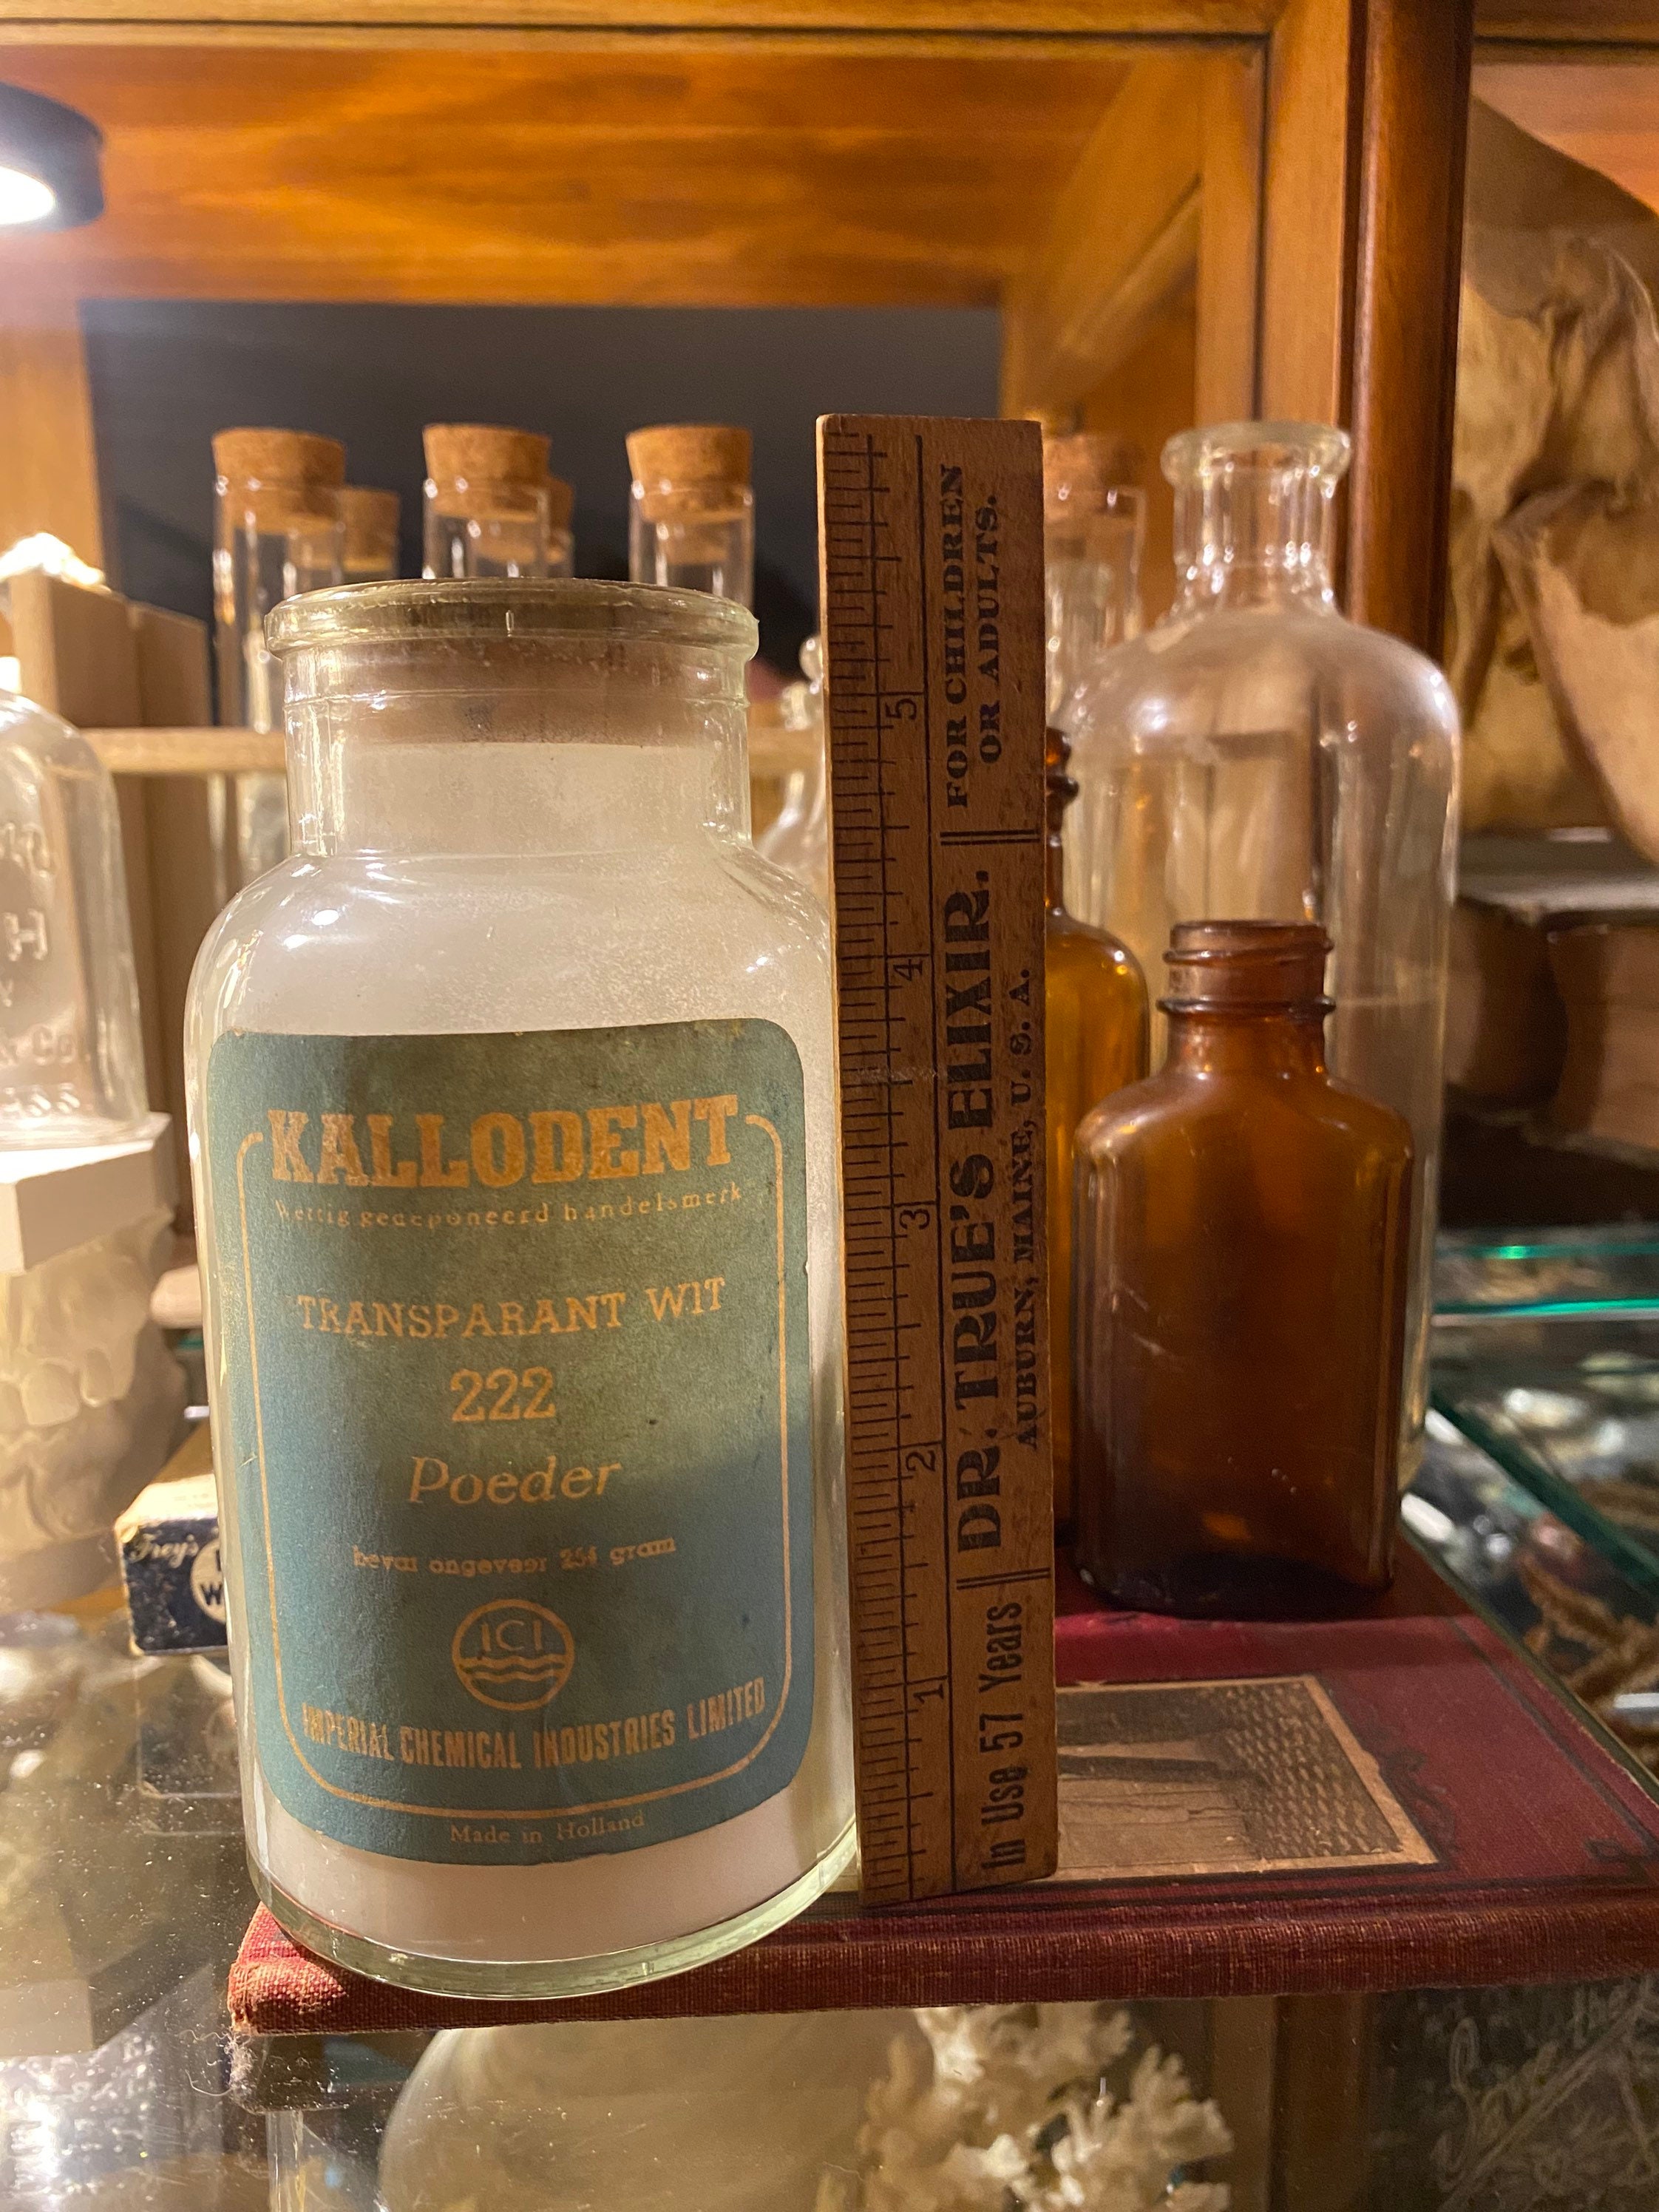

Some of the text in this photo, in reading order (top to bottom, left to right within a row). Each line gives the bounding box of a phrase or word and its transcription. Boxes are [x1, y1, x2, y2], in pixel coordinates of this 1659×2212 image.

[940, 464, 968, 808] FOR CHILDREN
[976, 495, 1002, 764] OR ADULTS.
[886, 697, 917, 721] 5
[892, 958, 923, 982] 4
[267, 1093, 739, 1189] KALLODENT
[359, 1202, 549, 1230] gedeponeerd
[563, 1181, 742, 1221] handelsmerk
[898, 1207, 931, 1230] 3
[943, 869, 1002, 1553] DR. TRUE'S ELIXIR.
[1011, 1119, 1036, 1264] MAINE,
[296, 1275, 726, 1340] TRANSPARANT WIT
[1014, 1276, 1039, 1450] AUBURN,
[450, 1366, 557, 1424] 222
[408, 1454, 623, 1505] Poeder
[905, 1449, 936, 1473] 2
[428, 1557, 548, 1578] ongeveer
[608, 1536, 677, 1567] gram
[479, 1618, 542, 1653] ICI
[912, 1682, 946, 1706] 1
[301, 1675, 766, 1770] IMPERIAL CHEMICAL INDUSTRIES LIMITED
[978, 1601, 1028, 1870] In Use 57 Years
[449, 1811, 645, 1845] Made in Holland
